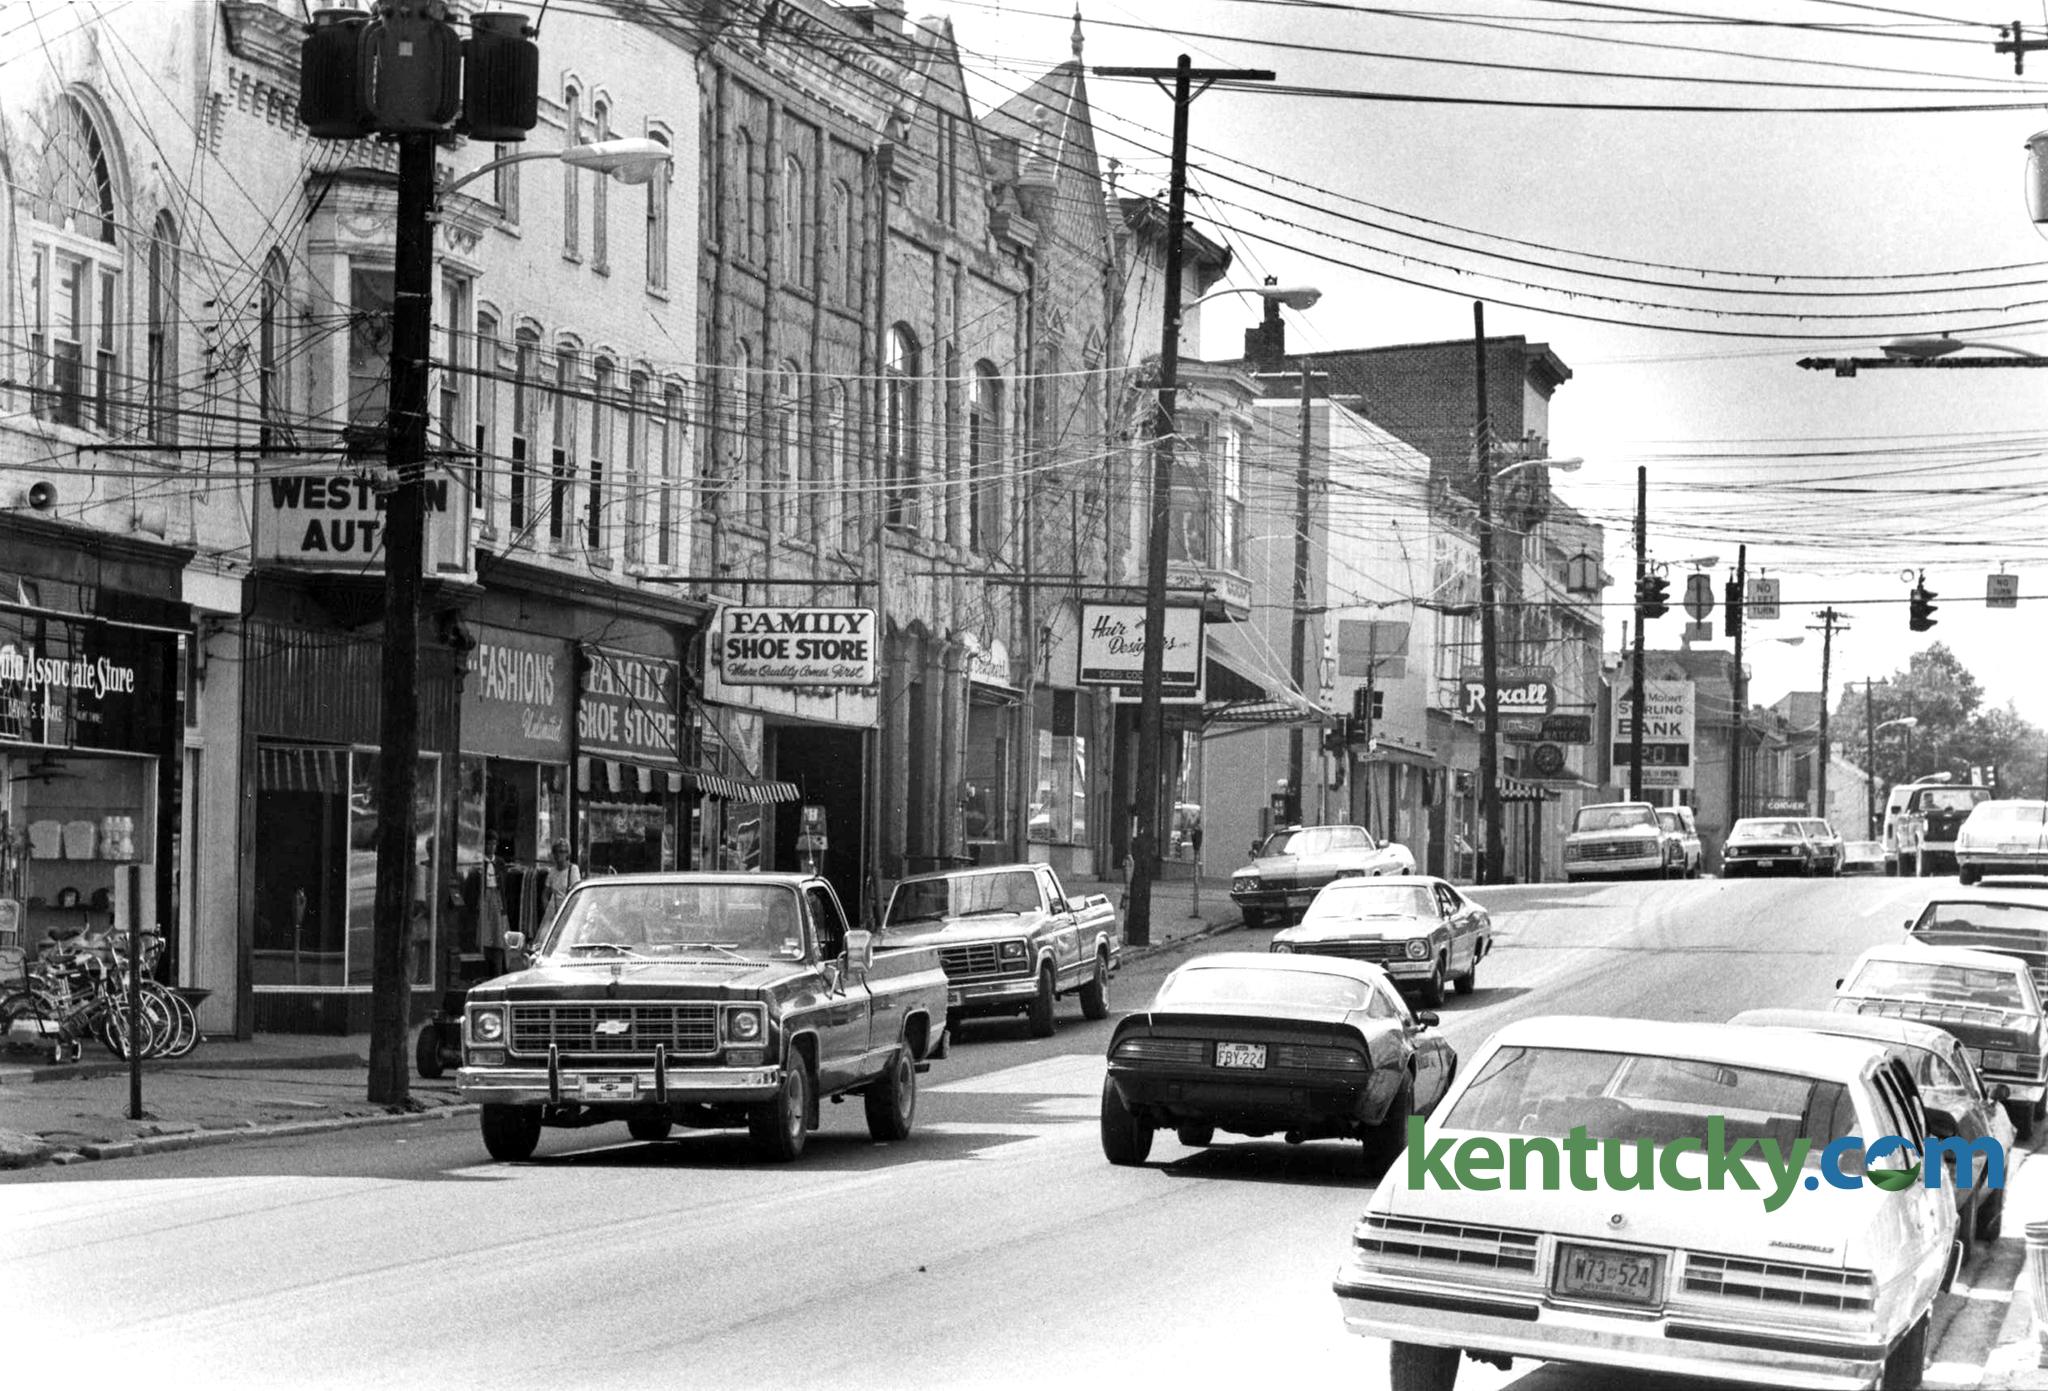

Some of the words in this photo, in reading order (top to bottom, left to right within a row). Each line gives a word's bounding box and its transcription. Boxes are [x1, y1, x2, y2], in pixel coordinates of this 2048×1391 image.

[270, 476, 448, 513] WESTN
[301, 518, 387, 553] AUT
[1756, 583, 1771, 593] NO
[730, 612, 869, 634] FAMILY
[1091, 615, 1128, 639] Hair
[726, 638, 790, 660] SHOE
[795, 638, 868, 661] STORE
[24, 647, 96, 691] Associate
[95, 656, 135, 699] Store
[587, 654, 669, 703] FAMILY
[727, 663, 757, 677] Where
[758, 664, 799, 680] Quality
[799, 664, 830, 678] Comes
[831, 664, 865, 679] First
[1466, 683, 1547, 713] Rxall
[1618, 702, 1684, 715] SRLING
[579, 699, 619, 742] SHOE
[624, 706, 676, 750] STORE
[1218, 1050, 1264, 1066] FBY-224
